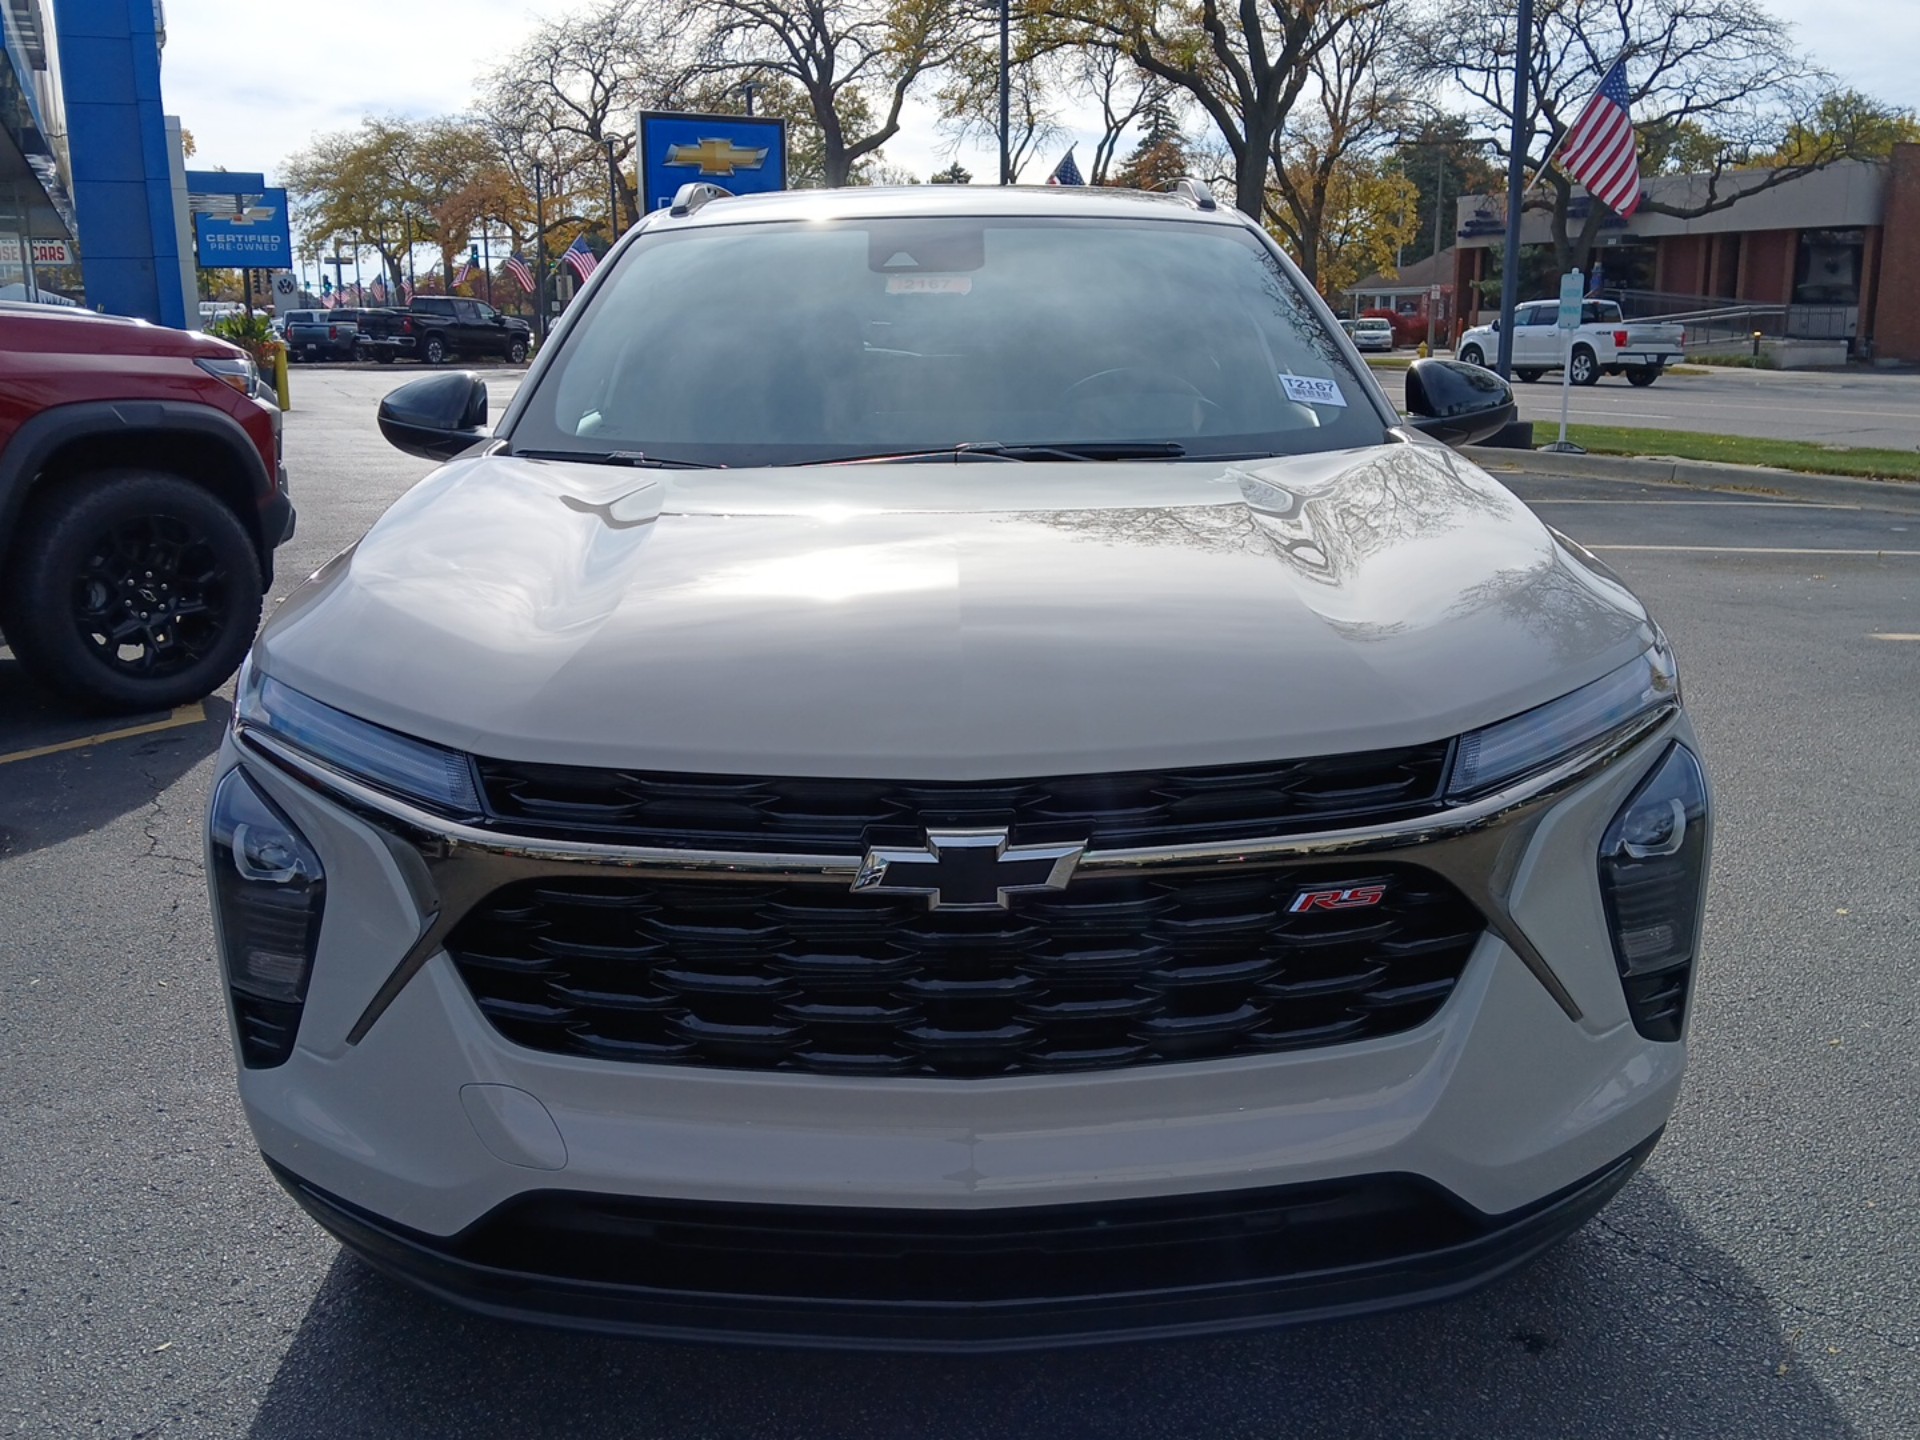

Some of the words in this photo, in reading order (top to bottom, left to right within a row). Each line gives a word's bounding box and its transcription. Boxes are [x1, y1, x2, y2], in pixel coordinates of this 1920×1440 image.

[206, 234, 281, 243] CERTIFIED
[0, 246, 24, 261] SE
[33, 246, 65, 261] CARS
[210, 243, 278, 252] PRE-OWNED
[1284, 378, 1334, 393] T2167
[1289, 885, 1387, 913] RS
